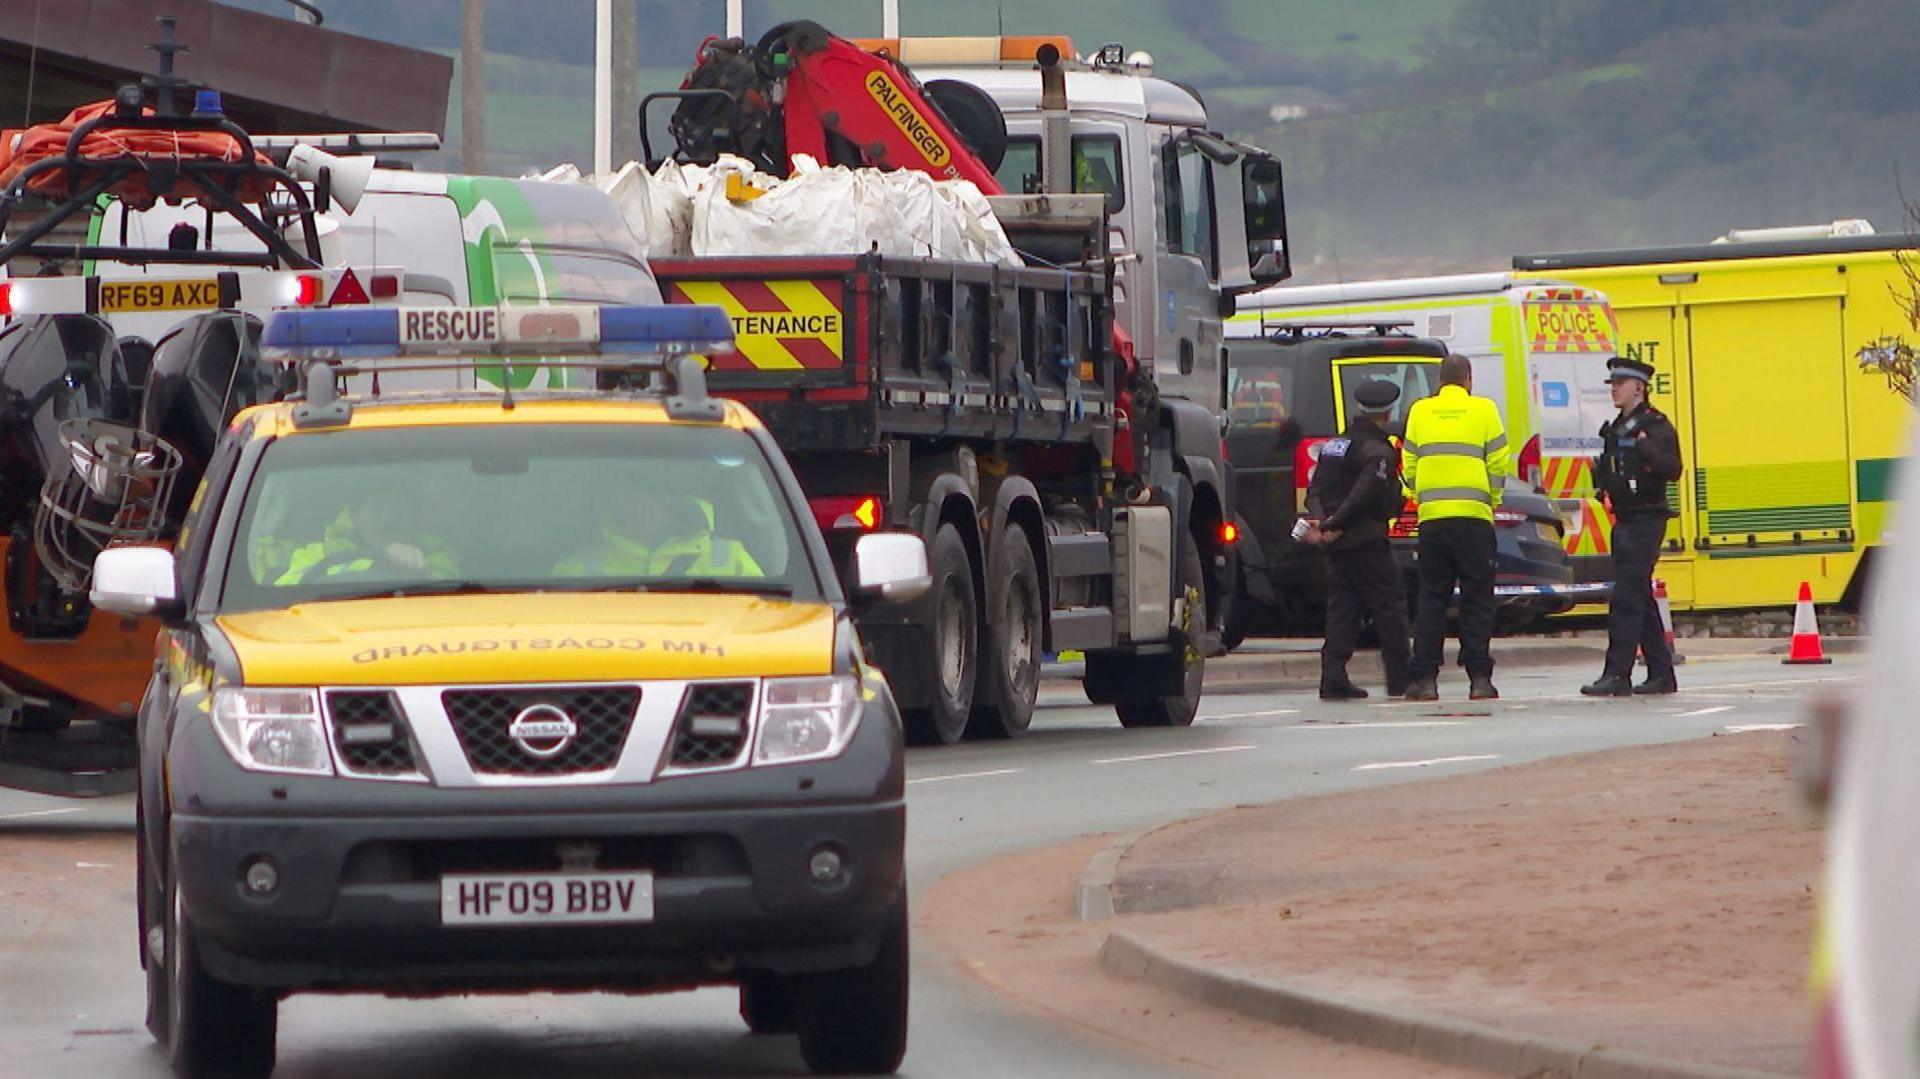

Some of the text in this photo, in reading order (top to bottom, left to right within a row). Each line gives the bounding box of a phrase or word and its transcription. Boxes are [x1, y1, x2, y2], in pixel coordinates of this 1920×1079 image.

[870, 75, 945, 162] PALFINGER
[101, 282, 218, 309] RF69 AXC
[406, 311, 495, 341] RESCUE
[731, 315, 838, 335] TENANCE
[1538, 312, 1599, 333] POLICE
[516, 723, 571, 736] NISSAN
[459, 879, 635, 916] HF09 BBV
